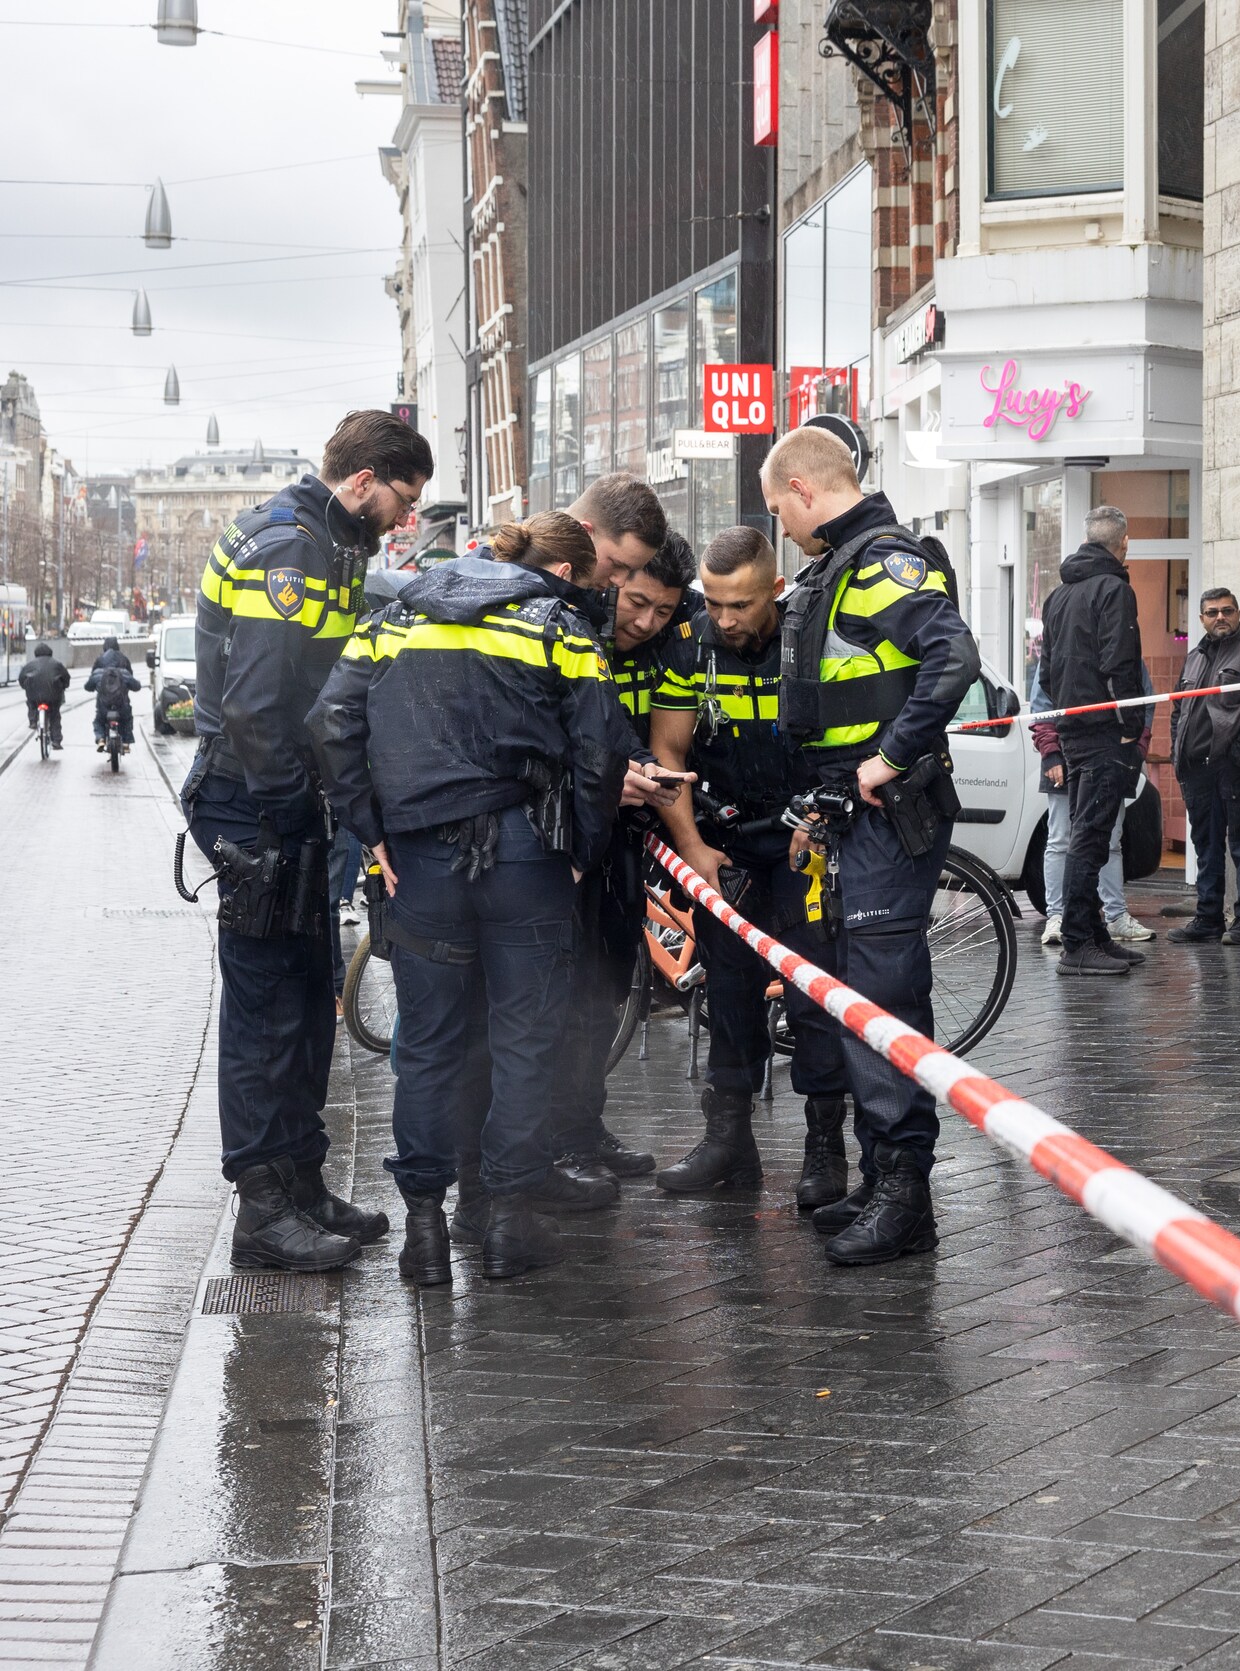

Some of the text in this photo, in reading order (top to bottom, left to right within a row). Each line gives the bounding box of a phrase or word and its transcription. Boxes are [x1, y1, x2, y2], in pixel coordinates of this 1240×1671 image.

[711, 372, 761, 397] UNI
[980, 359, 1092, 441] Lucy's
[711, 400, 766, 430] QLO
[678, 439, 730, 448] PULL&BEAR
[890, 556, 921, 566] POLITIE
[272, 574, 304, 584] POLITIE
[853, 909, 883, 921] POLITIE
